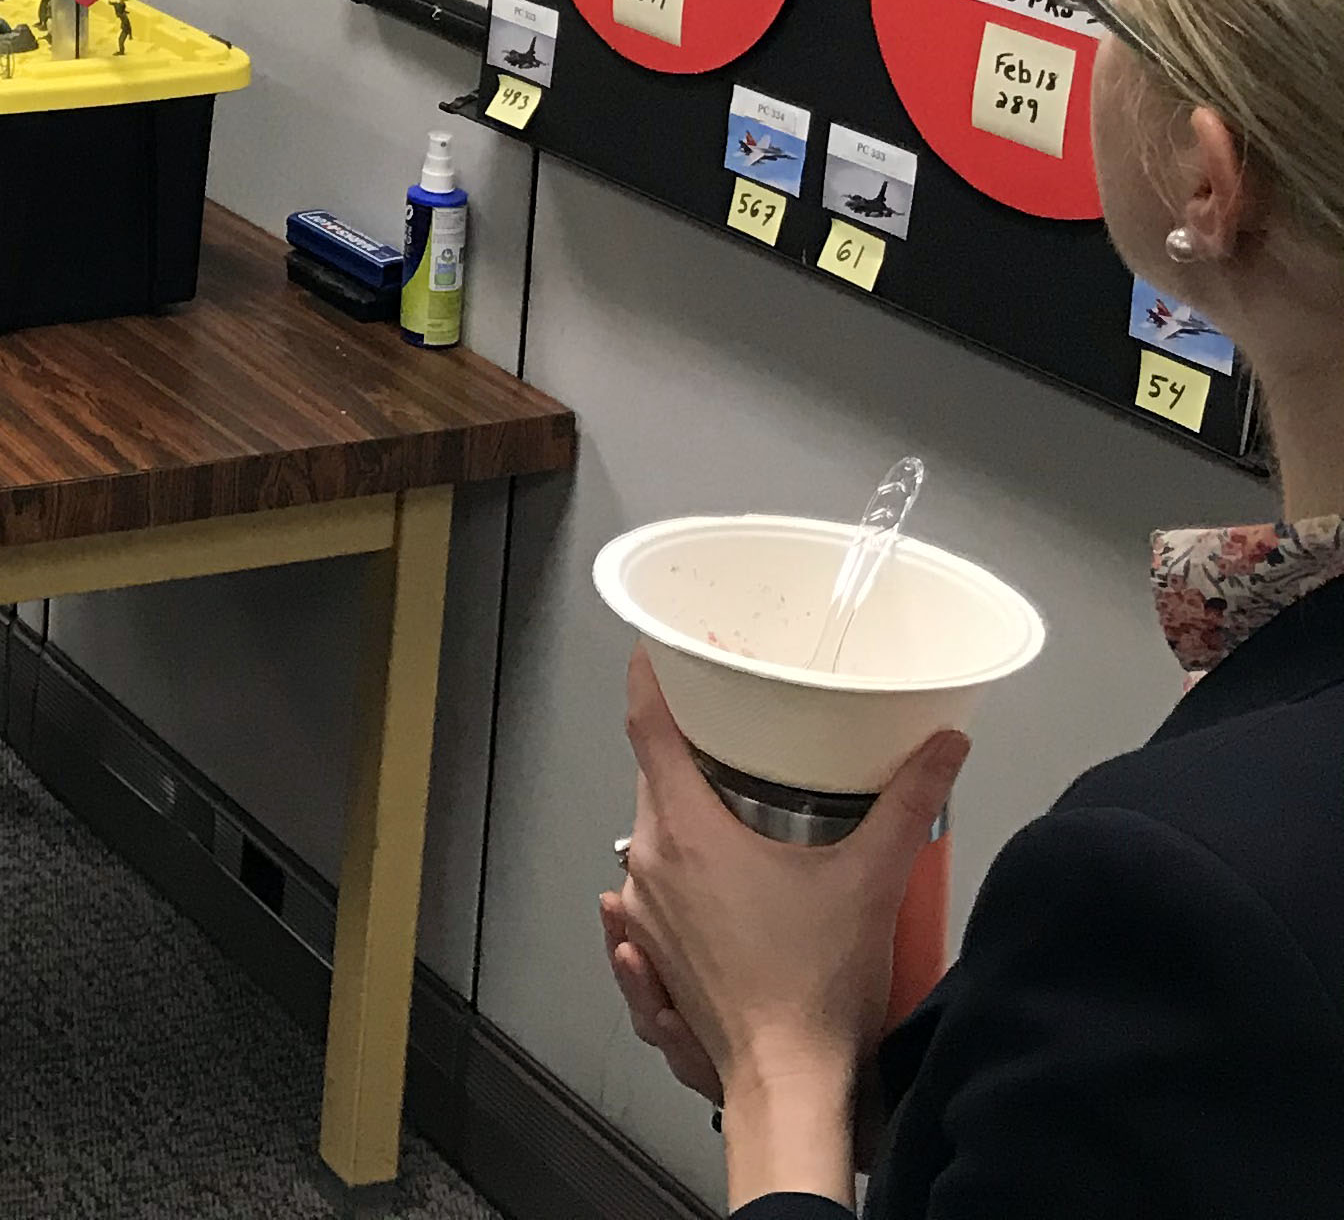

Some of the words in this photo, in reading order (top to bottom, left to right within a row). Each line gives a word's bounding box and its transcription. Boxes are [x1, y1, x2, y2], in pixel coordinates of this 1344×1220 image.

[994, 53, 1031, 84] Feb
[1036, 70, 1058, 91] 18
[757, 103, 770, 118] PC
[995, 92, 1039, 123] 289
[857, 142, 870, 155] PC
[737, 192, 777, 227] 567
[835, 239, 865, 269] 61
[1148, 373, 1186, 410] 54
